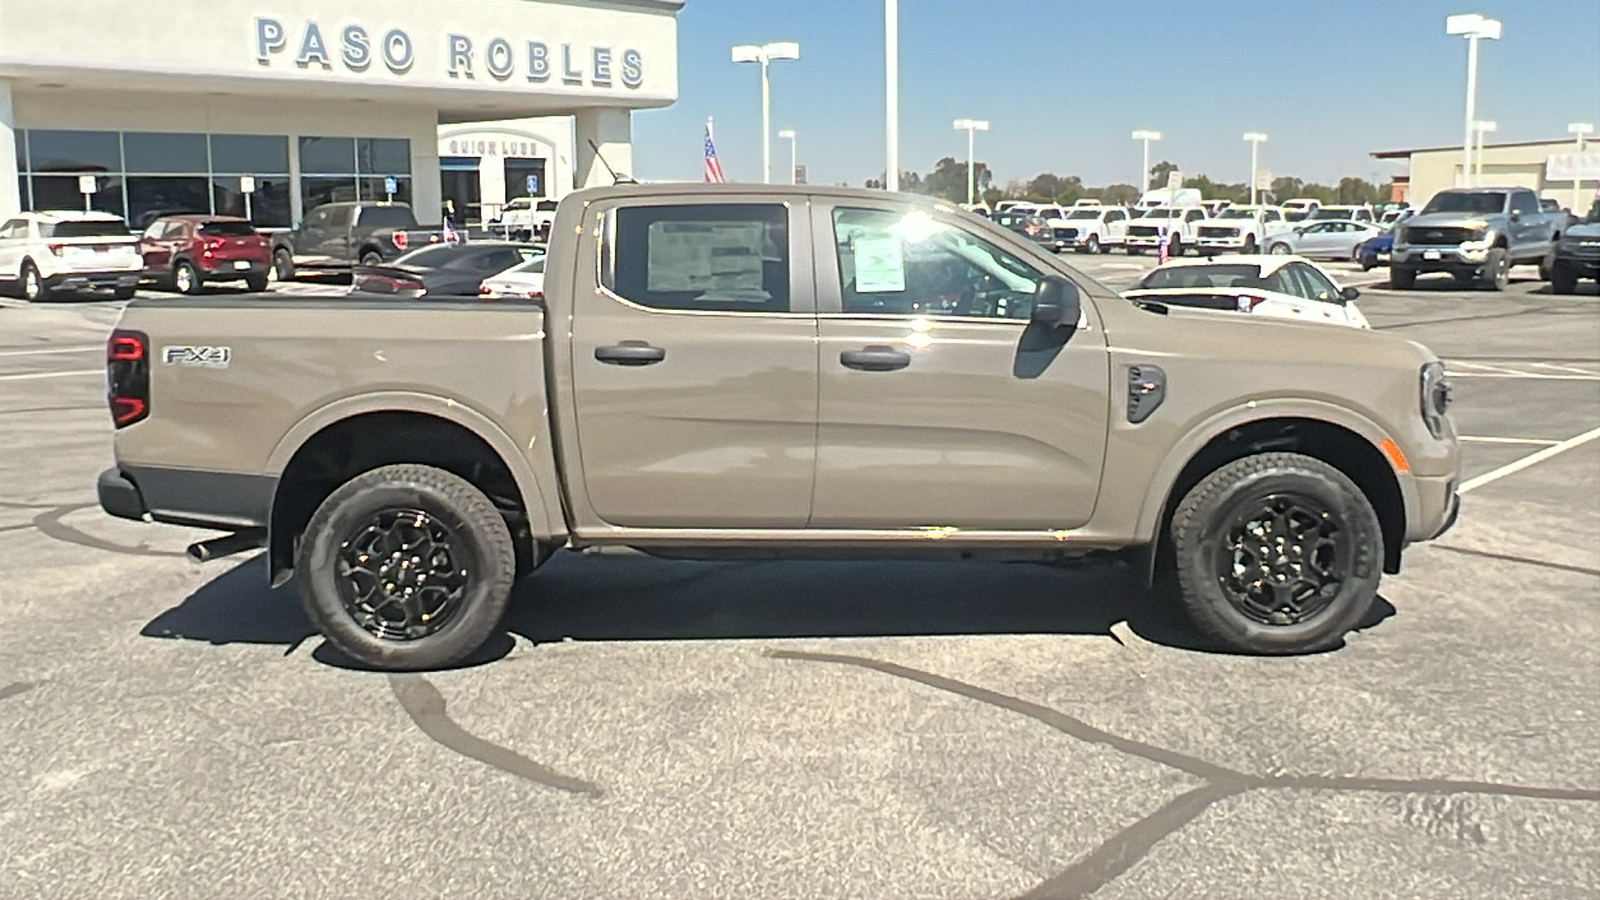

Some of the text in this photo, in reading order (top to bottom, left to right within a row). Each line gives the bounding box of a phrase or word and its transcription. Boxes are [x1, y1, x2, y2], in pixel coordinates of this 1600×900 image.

[253, 16, 644, 89] PASO ROBLES
[162, 346, 231, 367] FX4
